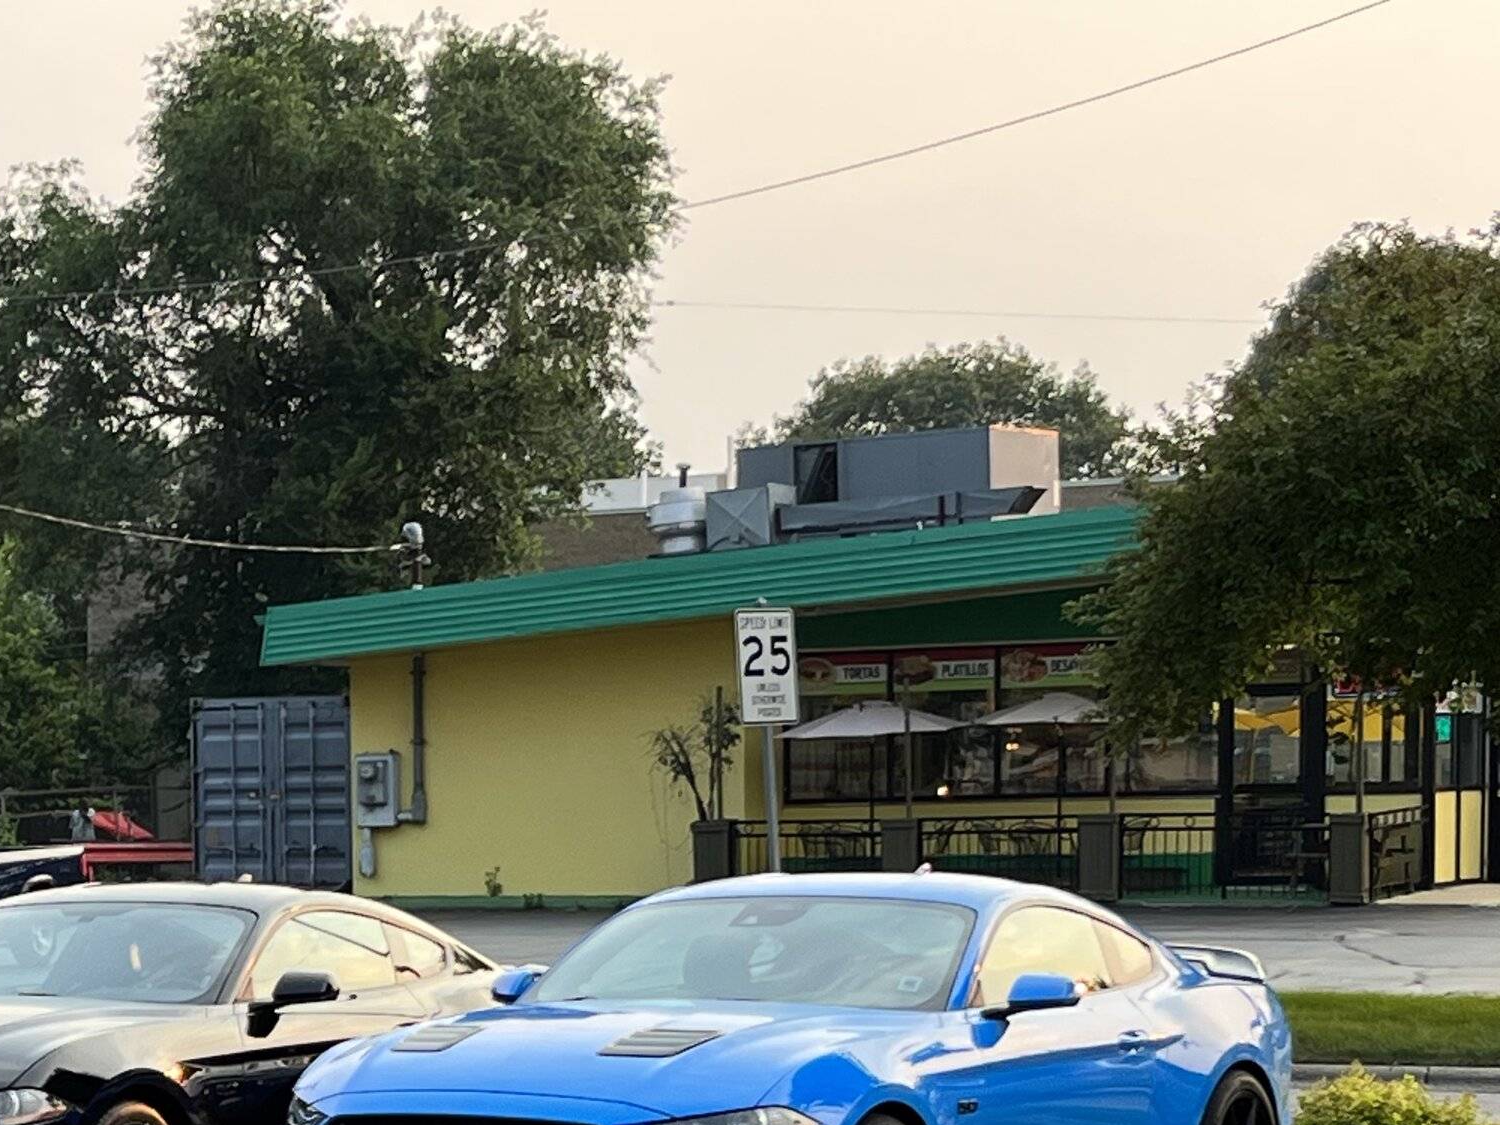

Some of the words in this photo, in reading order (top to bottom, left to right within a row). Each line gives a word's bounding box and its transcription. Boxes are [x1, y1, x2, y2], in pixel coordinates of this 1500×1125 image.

[742, 635, 790, 677] 25
[843, 665, 881, 680] TORTAS
[941, 662, 989, 677] PLATILLOS
